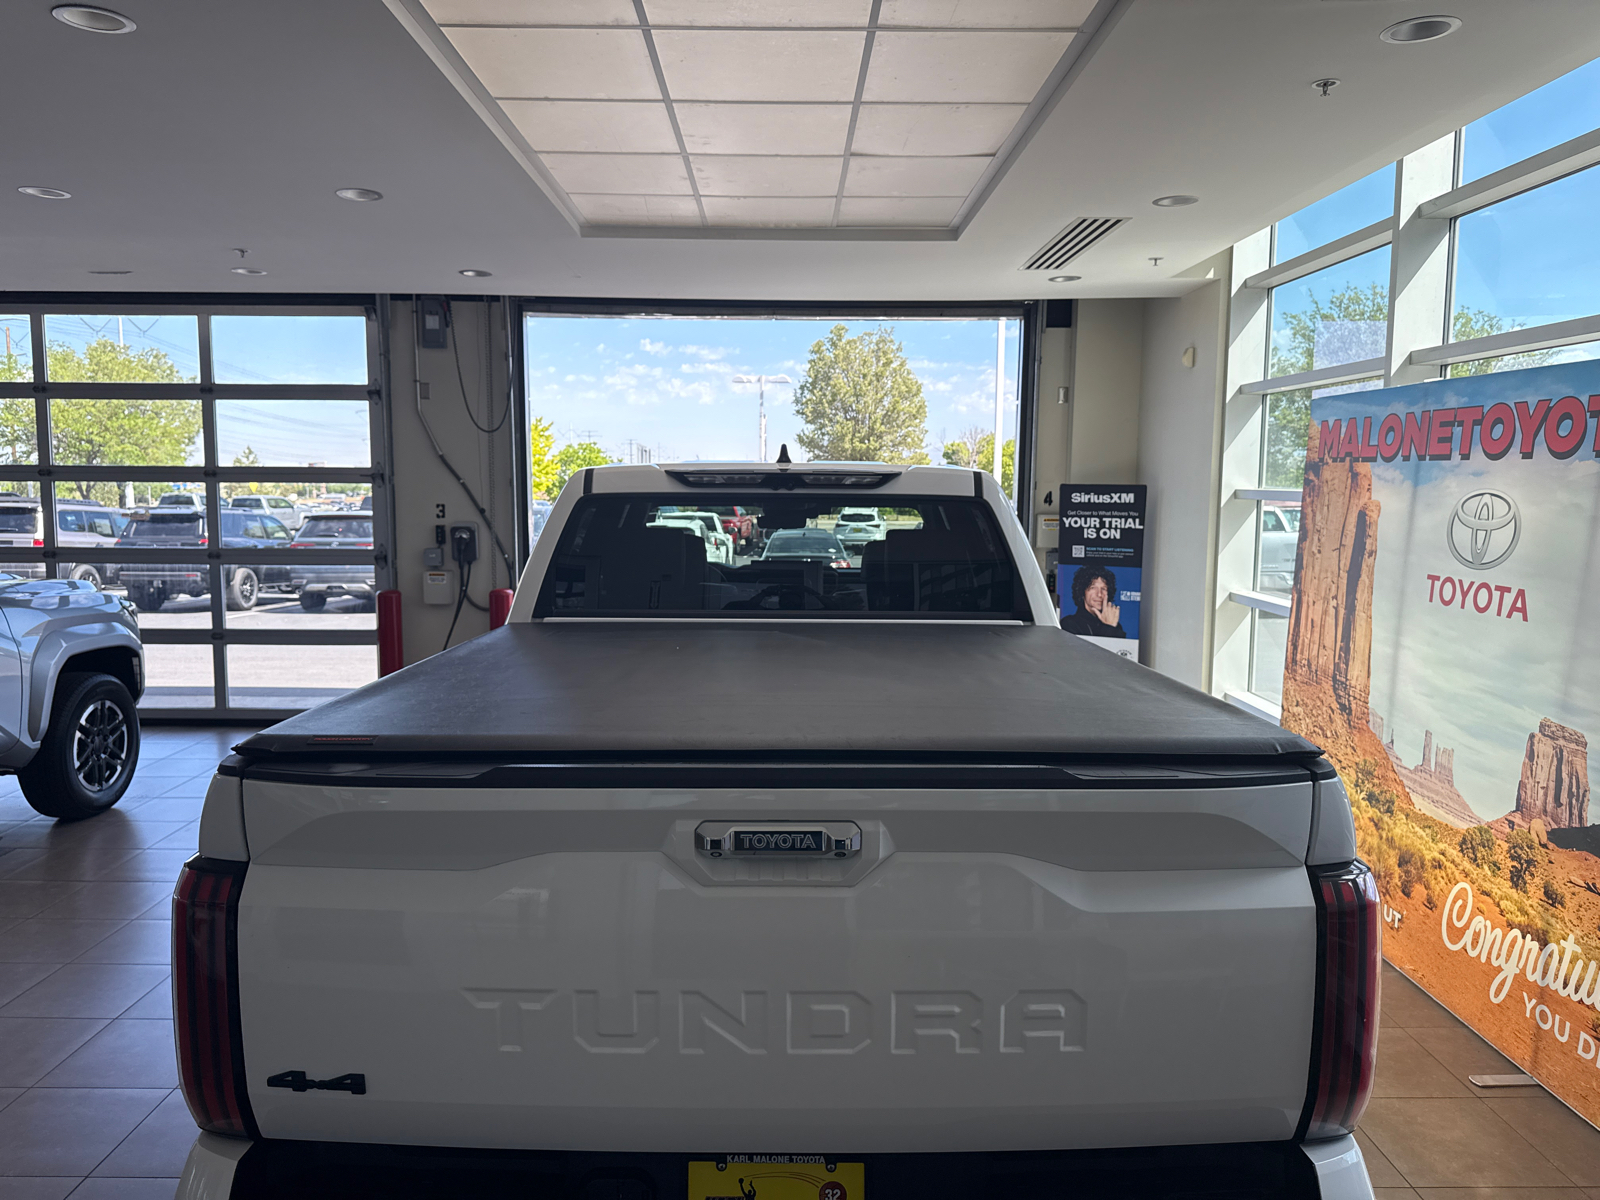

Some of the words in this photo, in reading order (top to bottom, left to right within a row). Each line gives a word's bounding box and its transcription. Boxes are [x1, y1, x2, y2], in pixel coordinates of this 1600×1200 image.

[1044, 491, 1053, 506] 4
[1071, 492, 1135, 504] SiriusXM
[436, 504, 445, 518] 3
[1062, 517, 1100, 528] YOUR
[1102, 518, 1144, 529] TRIAL
[1083, 528, 1097, 539] IS
[1099, 528, 1121, 540] ON
[1426, 573, 1529, 623] TOYOTA
[740, 834, 816, 849] TOYOTA
[1383, 903, 1402, 929] UT
[1441, 881, 1600, 1011] Congratu
[460, 986, 1088, 1056] TUNDRA
[1522, 991, 1570, 1043] YOU
[726, 1155, 751, 1163] KARL
[753, 1155, 790, 1164] MALONE
[792, 1155, 826, 1164] TOYOTA
[824, 1188, 841, 1200] 32
